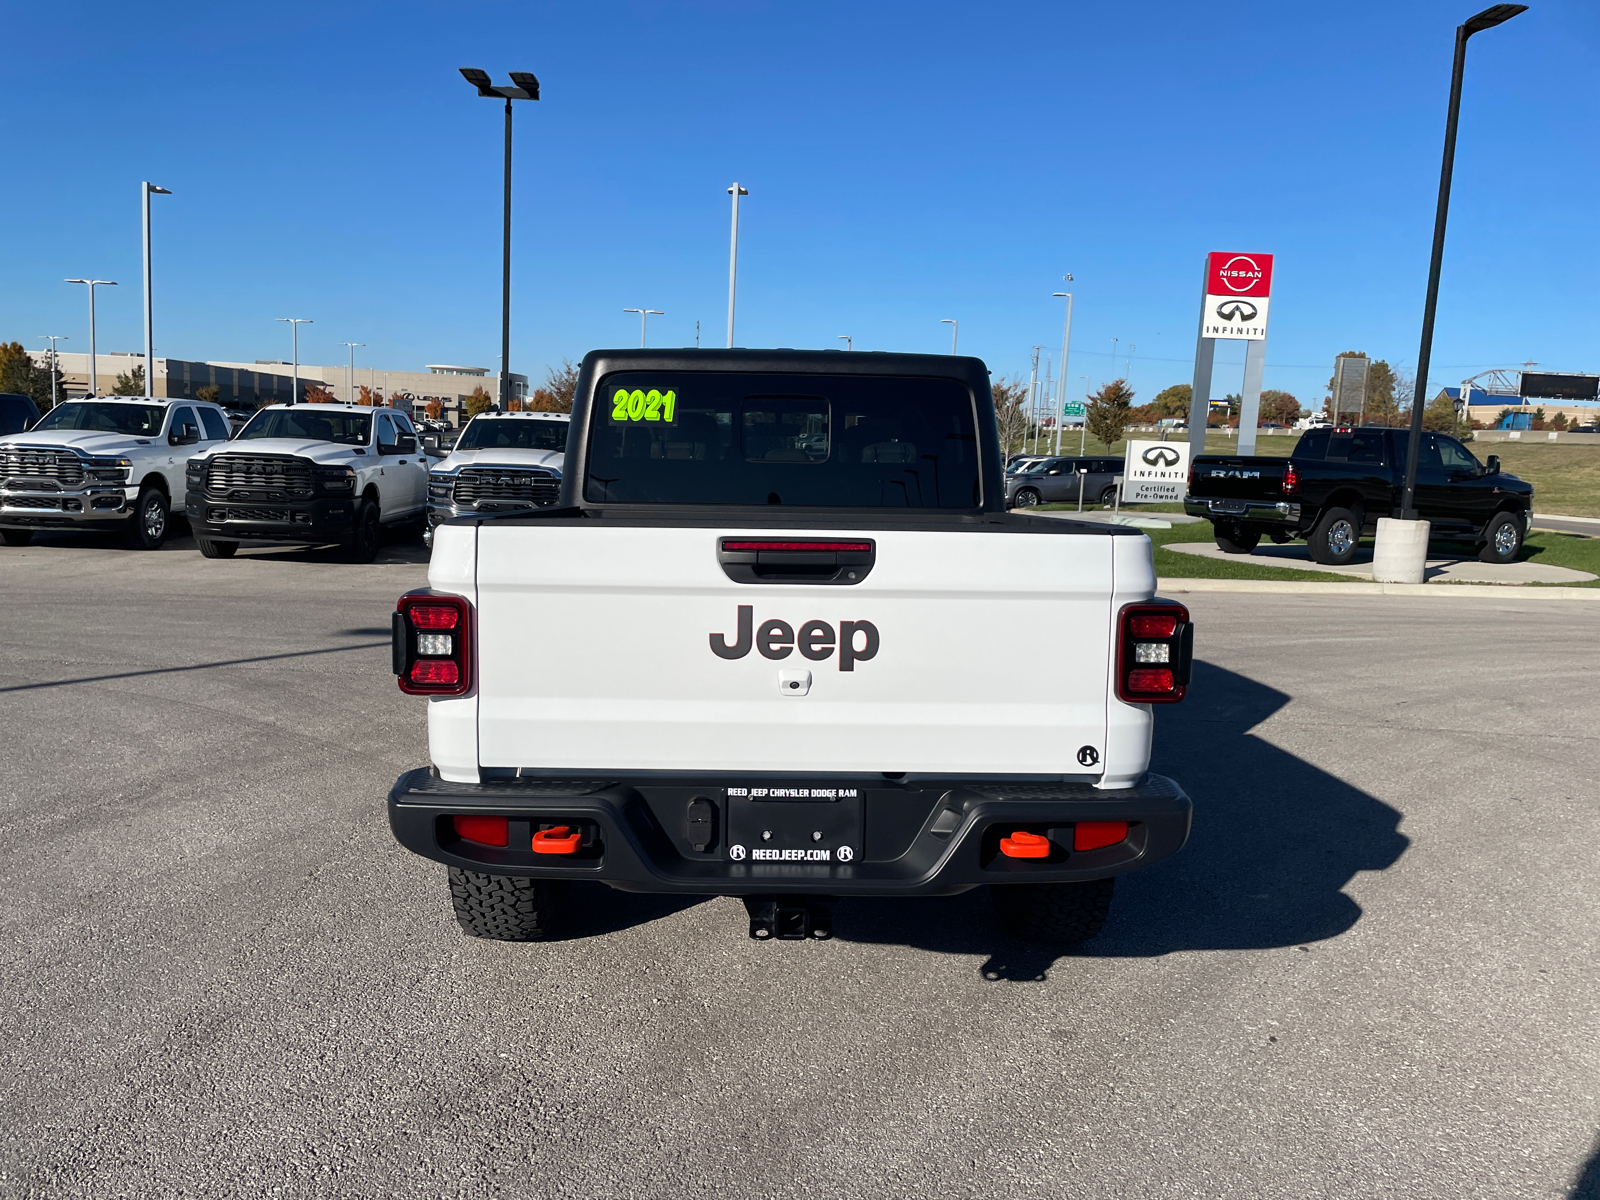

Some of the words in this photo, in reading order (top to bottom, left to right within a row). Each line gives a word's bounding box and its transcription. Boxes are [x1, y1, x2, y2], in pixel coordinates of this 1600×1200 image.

[1220, 270, 1262, 278] NISSAN
[1206, 325, 1264, 336] INFINITI
[611, 389, 676, 422] 2021
[231, 463, 283, 474] RAM
[1134, 470, 1184, 479] INFINITI
[1211, 469, 1260, 479] RAM
[480, 476, 531, 485] RAM
[1140, 485, 1175, 493] Certified
[1135, 492, 1179, 500] Pre-Owned
[708, 604, 880, 672] Jeep
[727, 787, 748, 797] REED
[750, 788, 768, 797] JEEP
[769, 788, 810, 798] CHRYSLER
[811, 789, 837, 798] DODGE
[838, 789, 858, 798] RAM
[752, 848, 831, 861] REEDJEEP.COM
